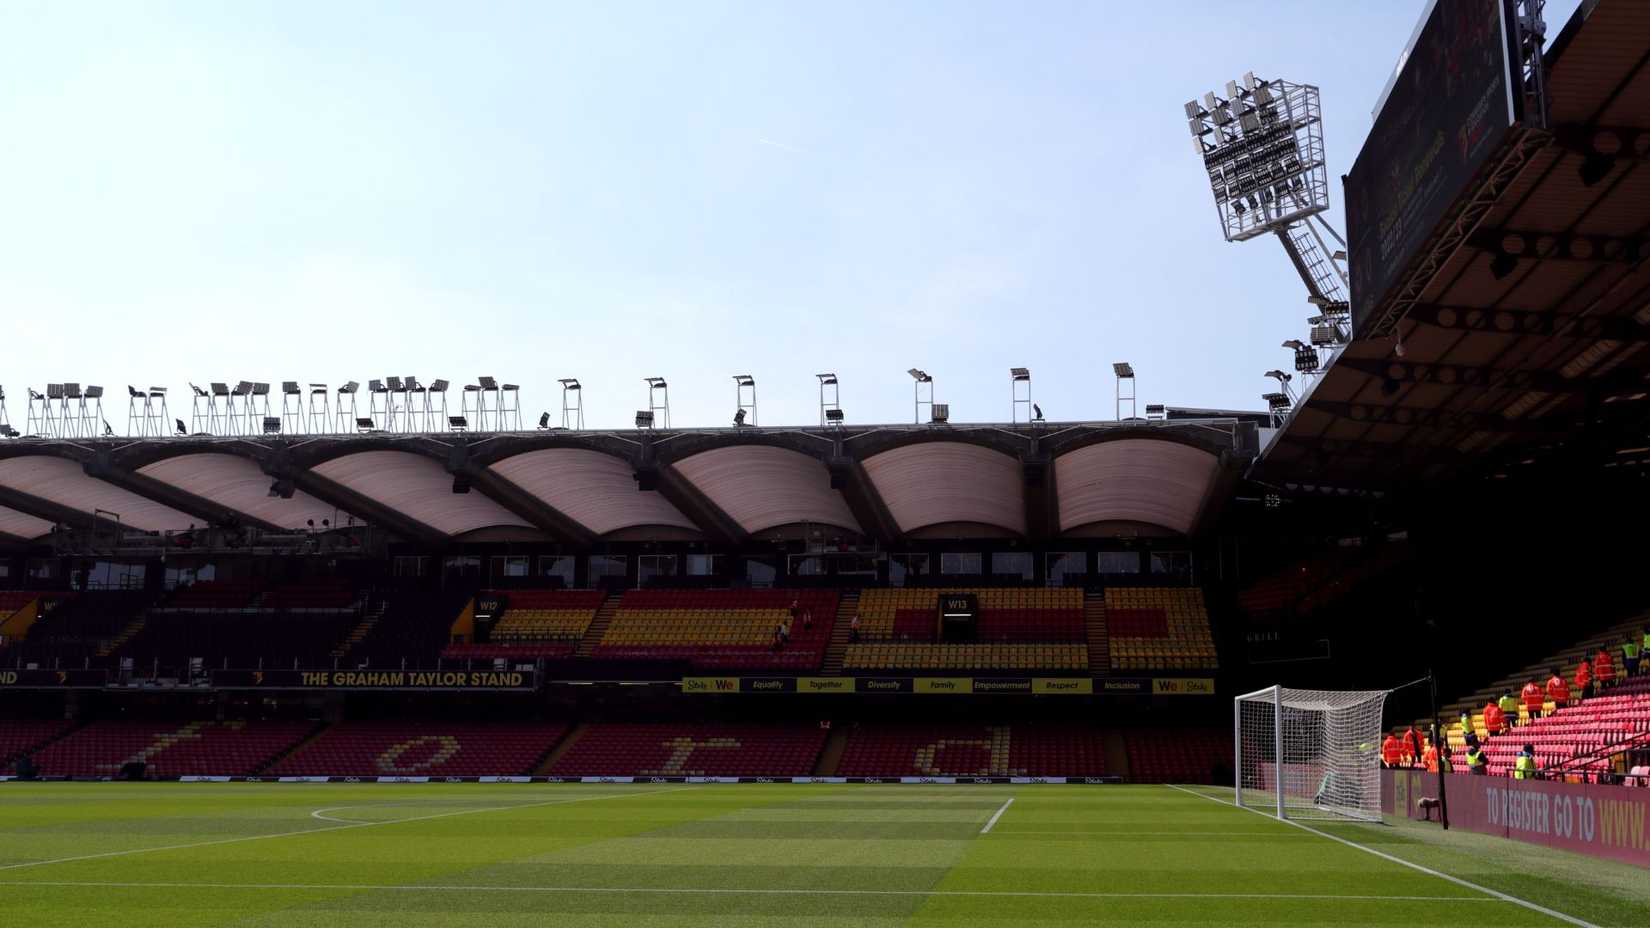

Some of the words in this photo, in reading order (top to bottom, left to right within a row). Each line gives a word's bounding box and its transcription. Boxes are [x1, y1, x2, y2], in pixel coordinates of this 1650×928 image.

[947, 599, 968, 609] W13
[302, 672, 329, 686] THE
[334, 672, 404, 686] GRAHAM
[407, 672, 466, 686] TAYLOR
[470, 672, 522, 686] STAND
[715, 680, 734, 690] We
[752, 680, 785, 691] Equality
[810, 680, 843, 690] Together
[867, 680, 902, 690] Diversity
[930, 680, 956, 690] Family
[974, 681, 1031, 691] Empowerment
[1046, 681, 1079, 690] Respect
[1487, 787, 1499, 824] TO
[1502, 789, 1550, 834] REGISTER
[1554, 794, 1573, 839] GO
[1577, 796, 1595, 842] TO
